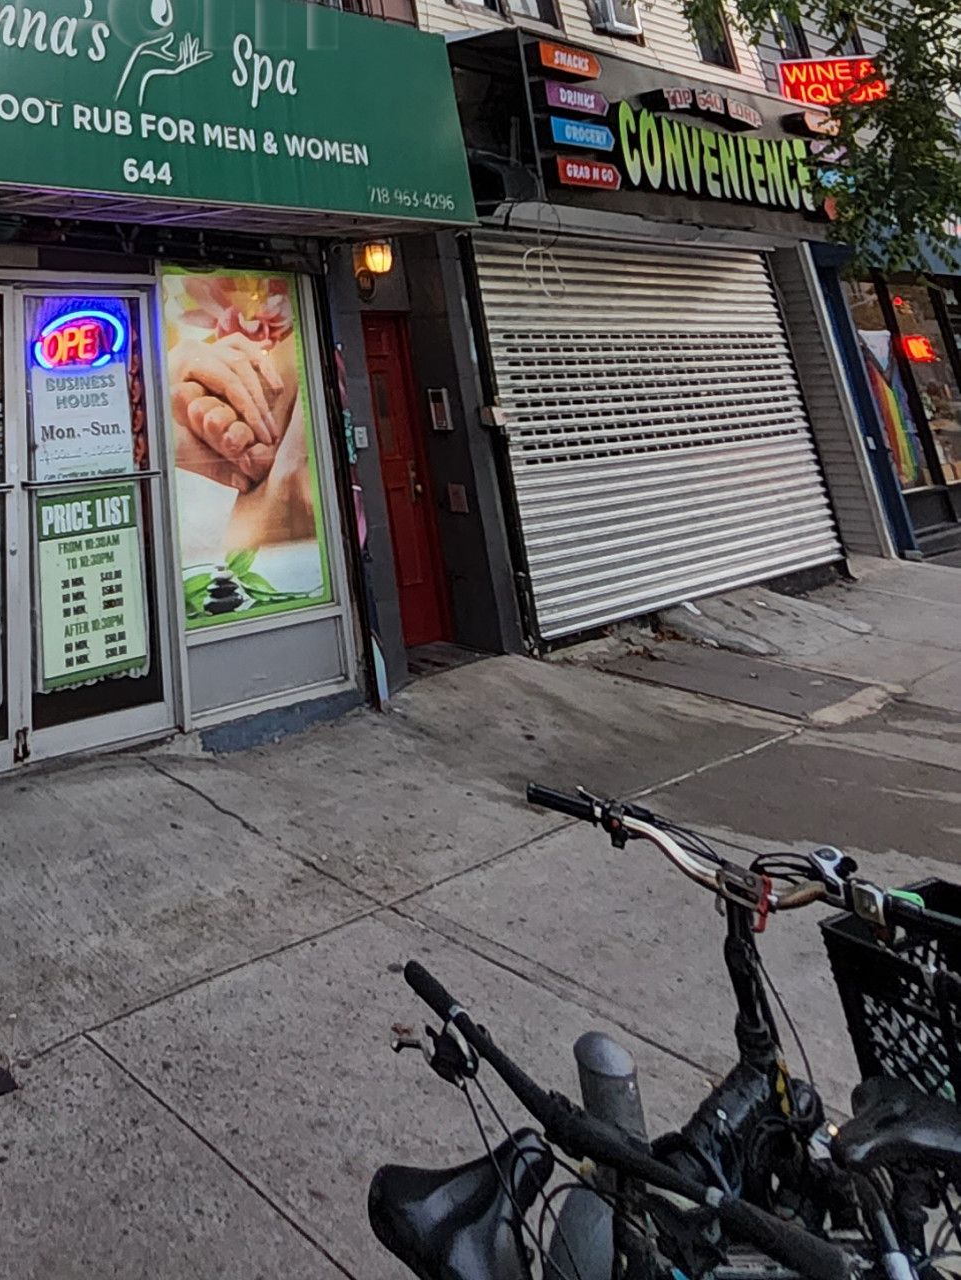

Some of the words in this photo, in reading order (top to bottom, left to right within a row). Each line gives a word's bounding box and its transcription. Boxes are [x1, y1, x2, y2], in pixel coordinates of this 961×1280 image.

[232, 33, 298, 108] Spa
[554, 50, 590, 71] SNACKS
[784, 61, 852, 84] WINE
[859, 61, 876, 78] &
[559, 87, 595, 109] DRINKS
[666, 89, 692, 106] TOP
[73, 103, 133, 136] RUB
[140, 113, 196, 144] FOR
[203, 123, 256, 152] MEN
[263, 131, 279, 155] &
[284, 133, 370, 166] WOMEN
[565, 124, 608, 145] GROCERY
[618, 99, 817, 212] CONVENIENCE
[123, 158, 173, 185] 644
[566, 163, 591, 180] GRAB
[592, 167, 600, 181] N
[601, 168, 614, 182] GO
[45, 374, 117, 392] BUSINESS
[56, 392, 110, 410] HOURS
[41, 500, 94, 536] PRICE
[95, 495, 131, 528] LIST
[58, 540, 82, 555] FROM
[66, 557, 78, 570] TO
[64, 621, 90, 638] AFTER
